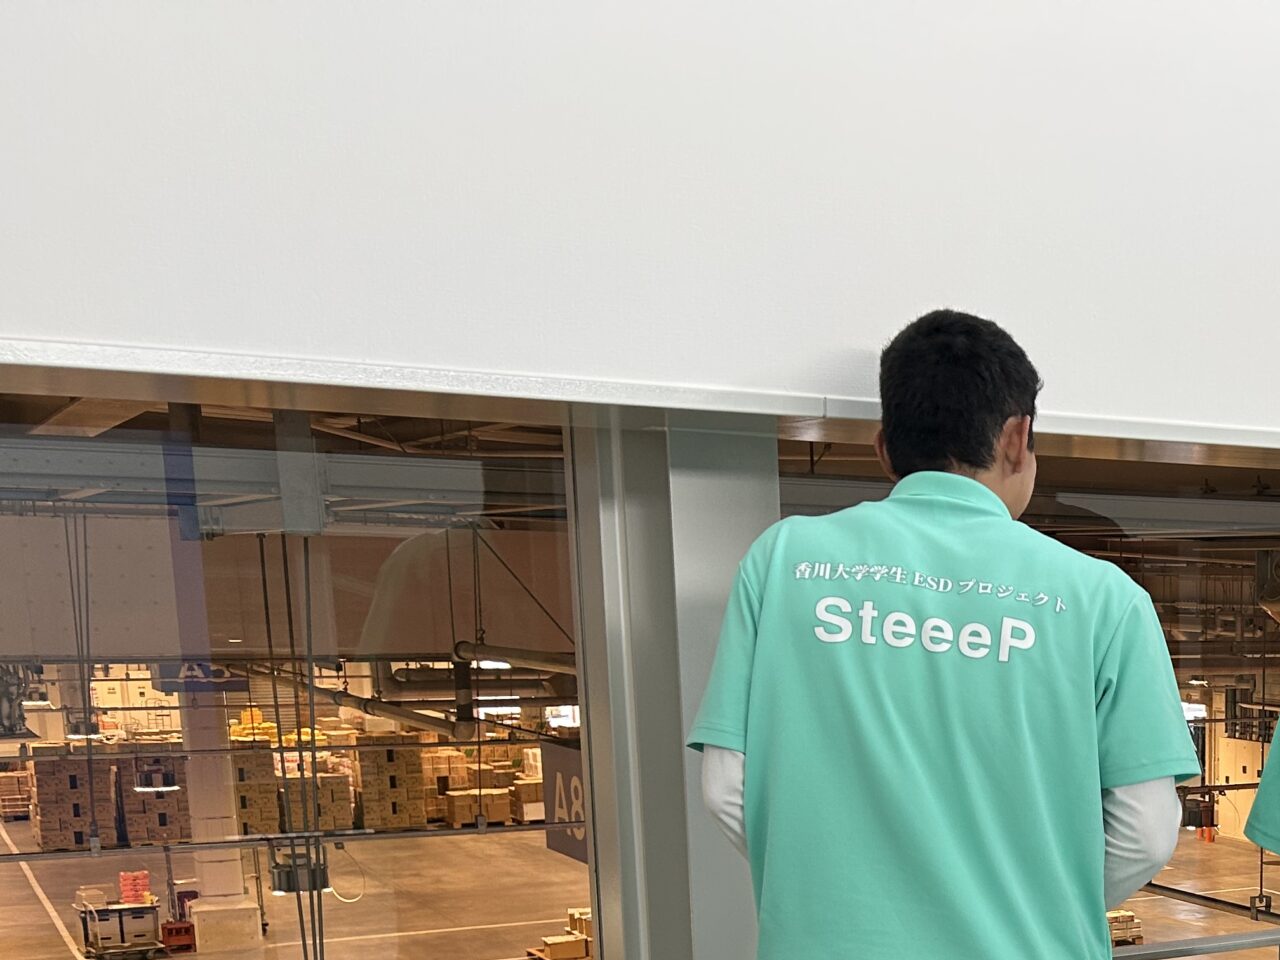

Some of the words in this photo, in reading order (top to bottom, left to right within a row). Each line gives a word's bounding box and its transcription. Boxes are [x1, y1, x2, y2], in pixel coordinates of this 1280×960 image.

[794, 562, 908, 585] 香川大学学生
[913, 572, 953, 593] ESD
[958, 578, 1067, 613] プロジェクト
[814, 596, 1036, 663] SteeeP
[554, 771, 586, 841] A8
